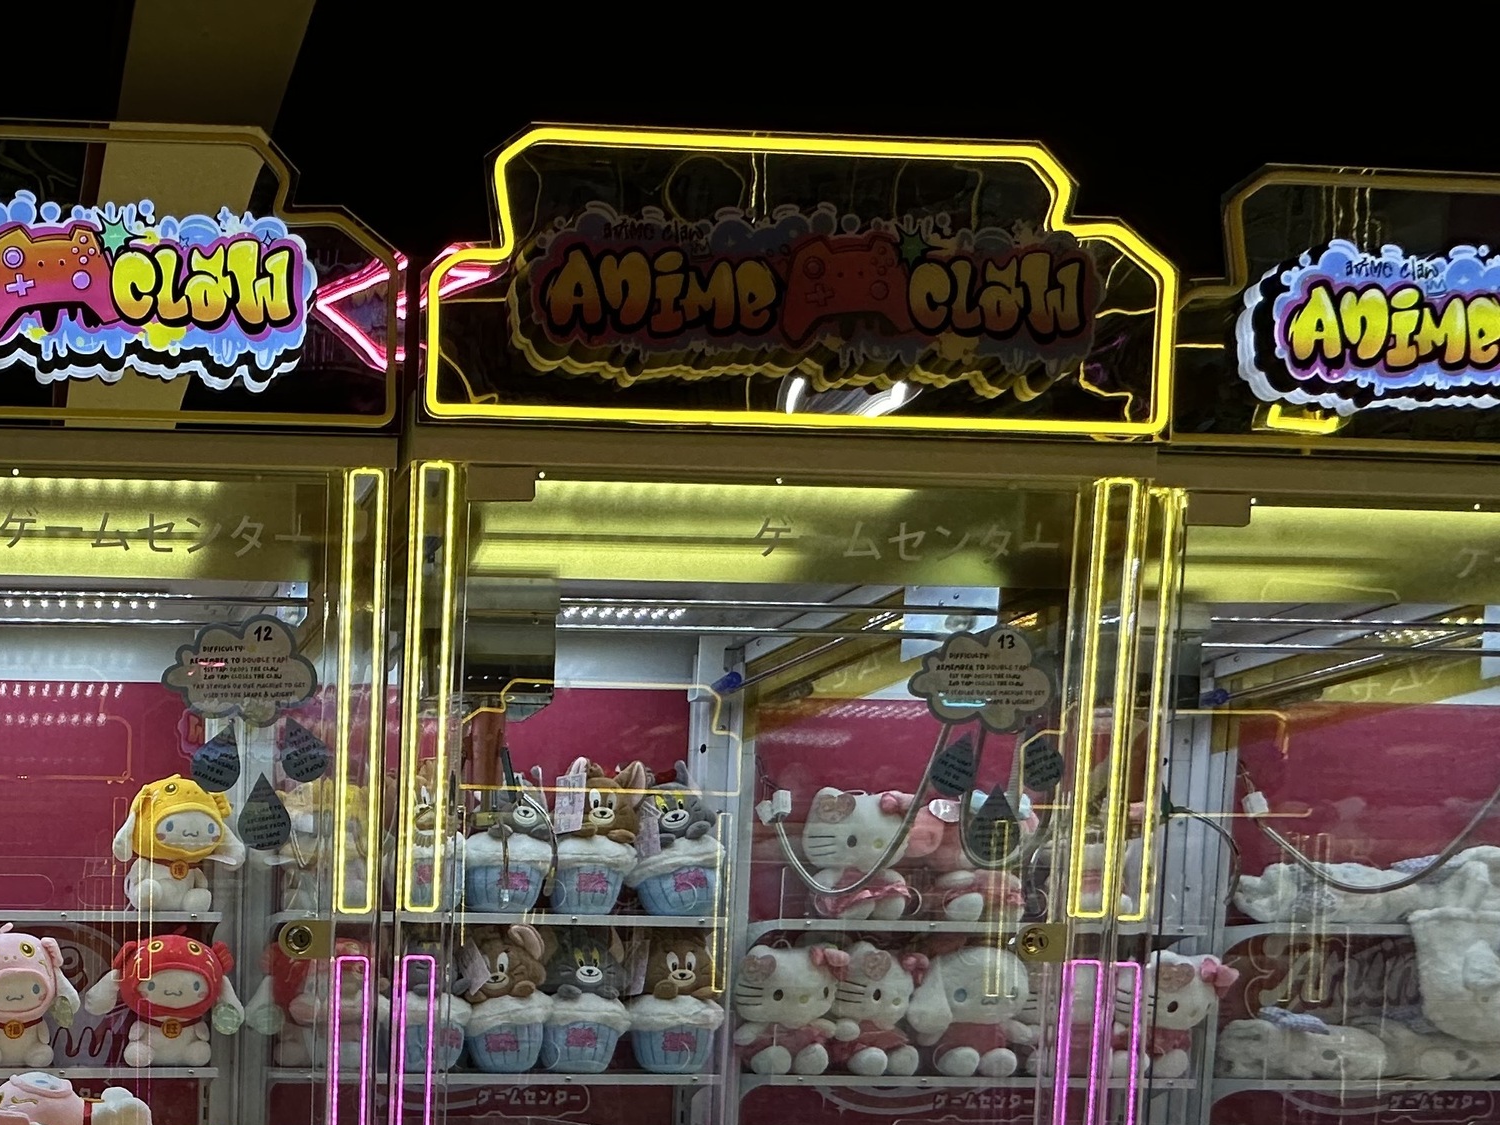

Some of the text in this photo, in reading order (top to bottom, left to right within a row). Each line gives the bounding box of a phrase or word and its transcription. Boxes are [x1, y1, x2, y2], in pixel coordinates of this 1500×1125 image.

[754, 517, 1059, 564] ゲムセンター
[254, 625, 273, 642] 12
[997, 634, 1016, 649] 13
